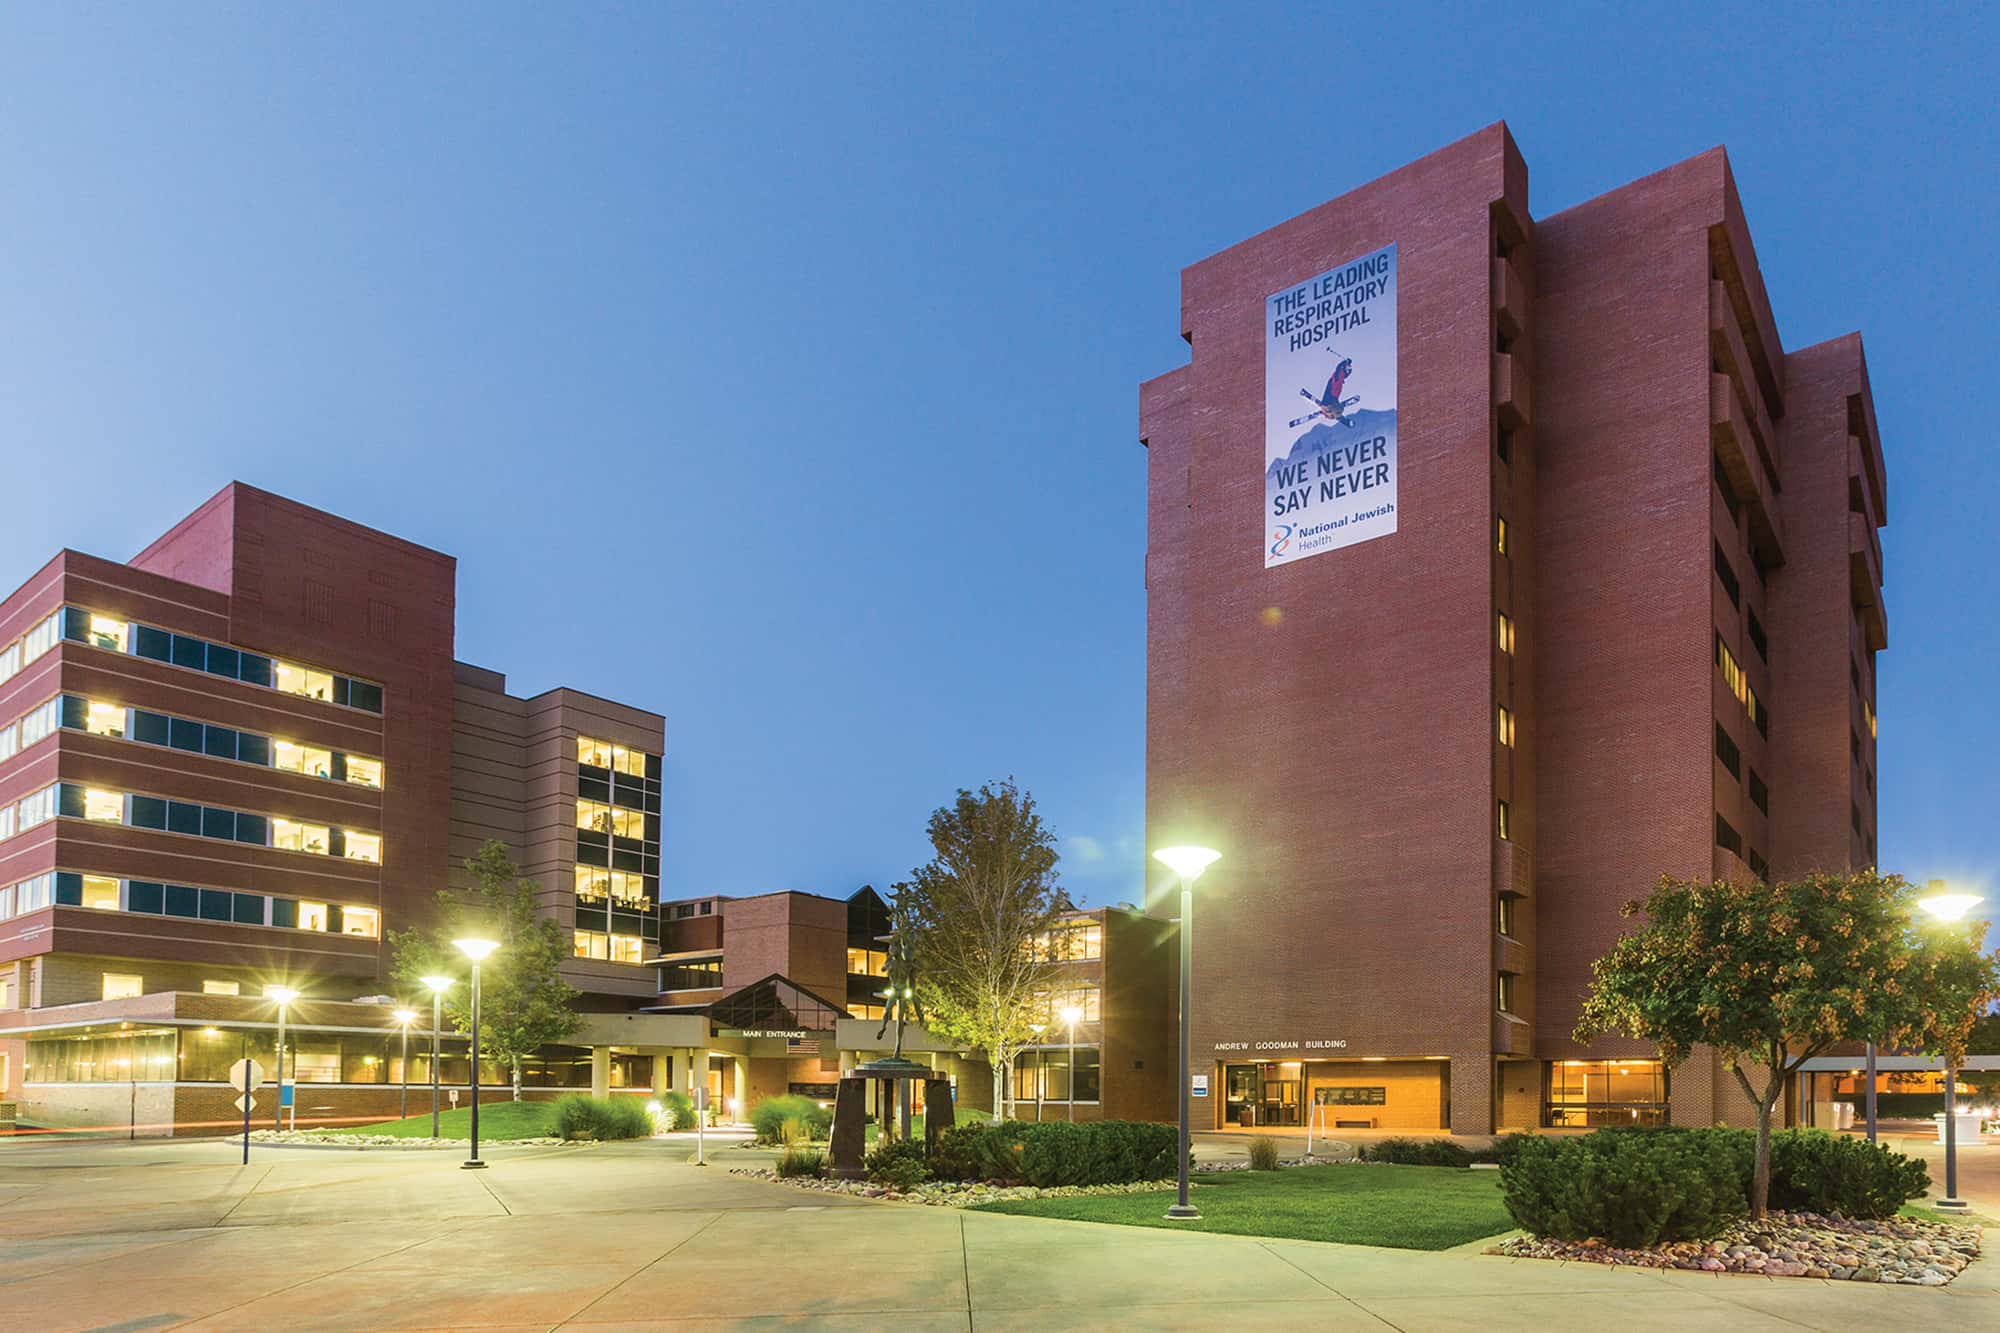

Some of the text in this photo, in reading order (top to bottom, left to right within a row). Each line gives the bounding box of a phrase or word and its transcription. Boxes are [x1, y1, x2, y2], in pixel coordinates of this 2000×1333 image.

[1273, 253, 1389, 316] THE LEADING
[1274, 275, 1389, 338] RESPIRATORY
[1290, 306, 1371, 352] HOSPITAL
[1276, 436, 1387, 490] WE NEVER
[1273, 462, 1389, 516] SAY NEVER
[1299, 503, 1395, 538] National Jewish
[1299, 534, 1332, 551] Health
[742, 1030, 806, 1039] MAIN ENTRANCE
[1214, 1040, 1347, 1051] ANDREW GOODMAN BUILDING
